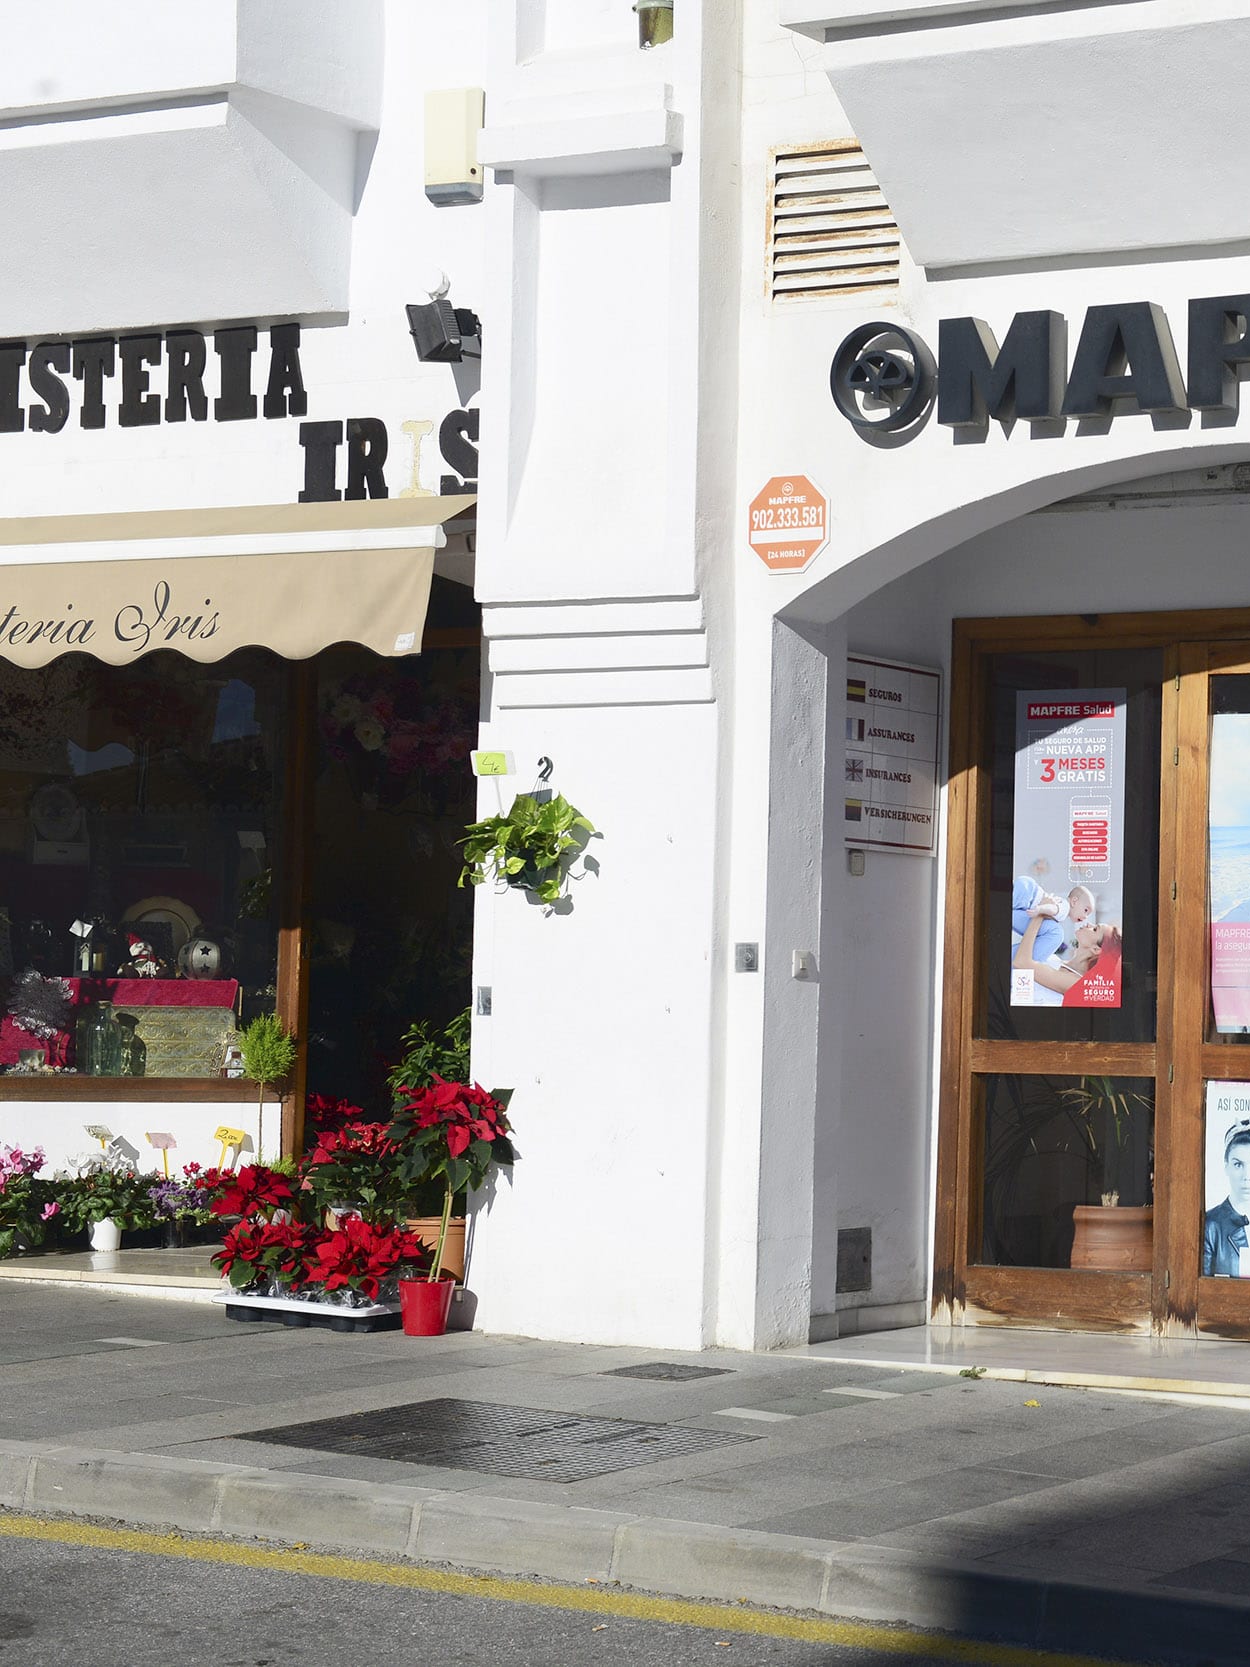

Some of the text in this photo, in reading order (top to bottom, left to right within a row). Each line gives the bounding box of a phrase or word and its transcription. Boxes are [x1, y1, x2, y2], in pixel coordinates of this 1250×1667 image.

[0, 322, 307, 434] ISTERIA
[298, 408, 479, 503] IRIS
[769, 495, 807, 505] MAPFRE
[752, 505, 824, 529] 902.333.581
[114, 580, 221, 652] Iris
[868, 688, 902, 702] SEGUROS
[1030, 704, 1112, 716] MAPFRE Salud
[867, 727, 915, 743] ASSURANCES
[1044, 737, 1072, 745] SEGURO
[1046, 745, 1084, 755] NUEVA
[1085, 744, 1106, 754] APP
[865, 768, 911, 783] INSURANCES
[1040, 758, 1055, 783] 3
[1058, 757, 1105, 770] MESES
[1057, 770, 1106, 782] GRATIS
[864, 806, 932, 824] VERSICHERUNGEN
[1215, 941, 1222, 950] la
[1217, 1097, 1232, 1111] ASÍ
[1234, 1098, 1250, 1112] SON
